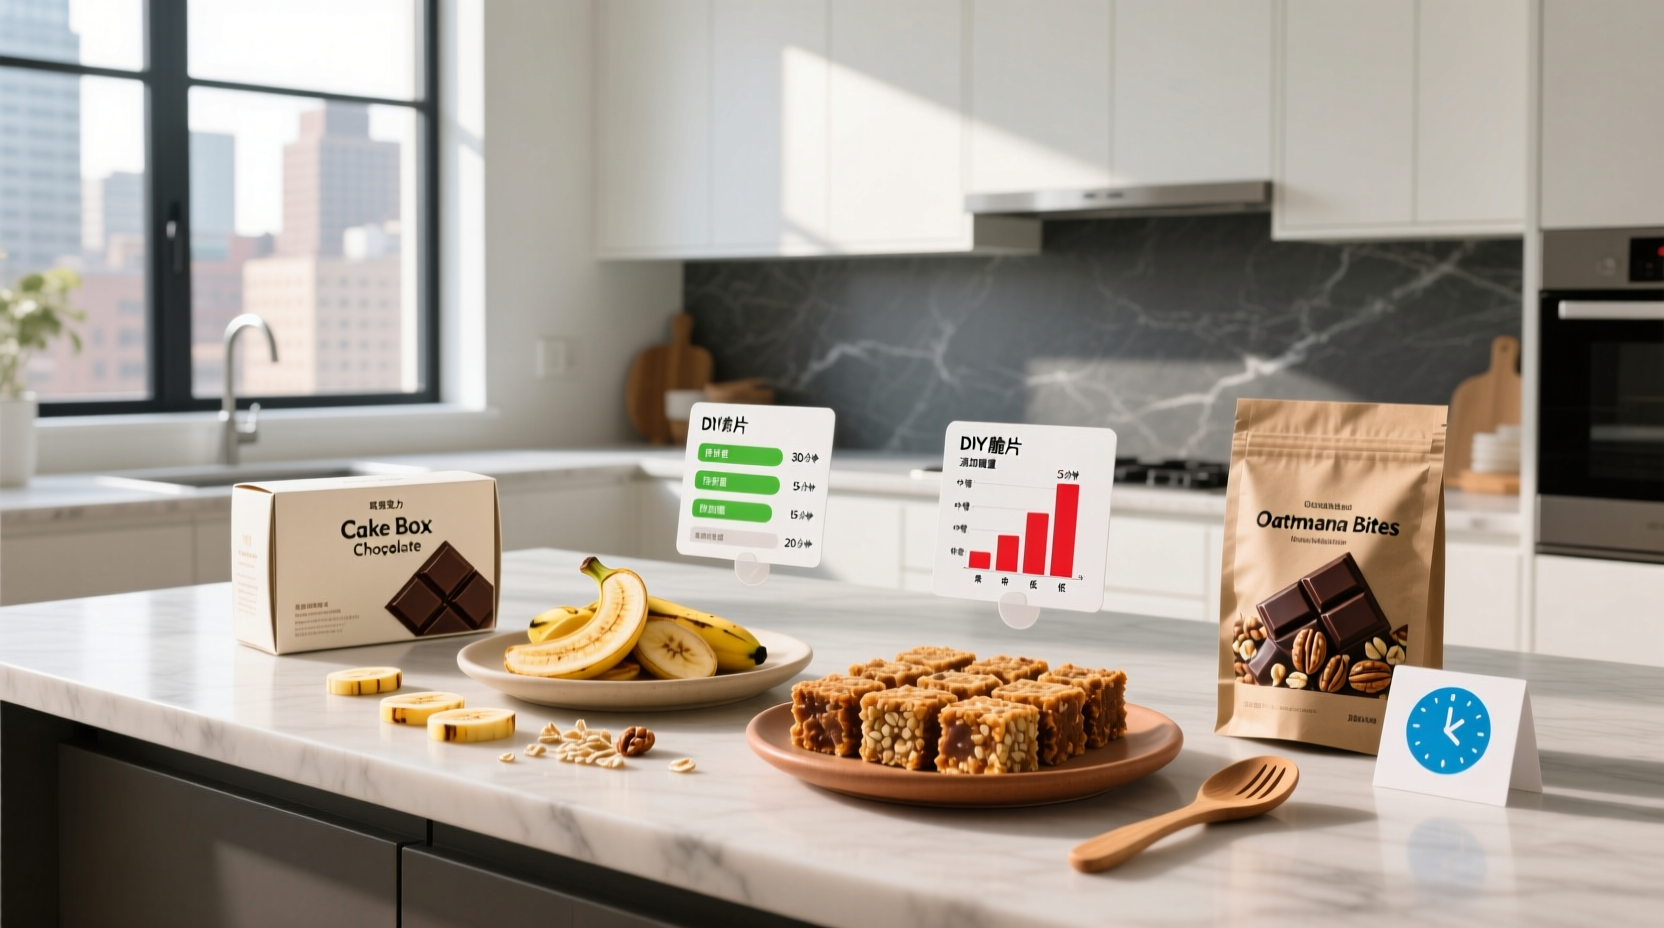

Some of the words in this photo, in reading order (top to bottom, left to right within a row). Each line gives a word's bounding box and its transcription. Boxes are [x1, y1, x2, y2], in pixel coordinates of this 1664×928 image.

[341, 518, 391, 540] Cake
[395, 516, 433, 535] Box
[1352, 515, 1400, 537] Bites
[353, 539, 422, 557] Chocolate
